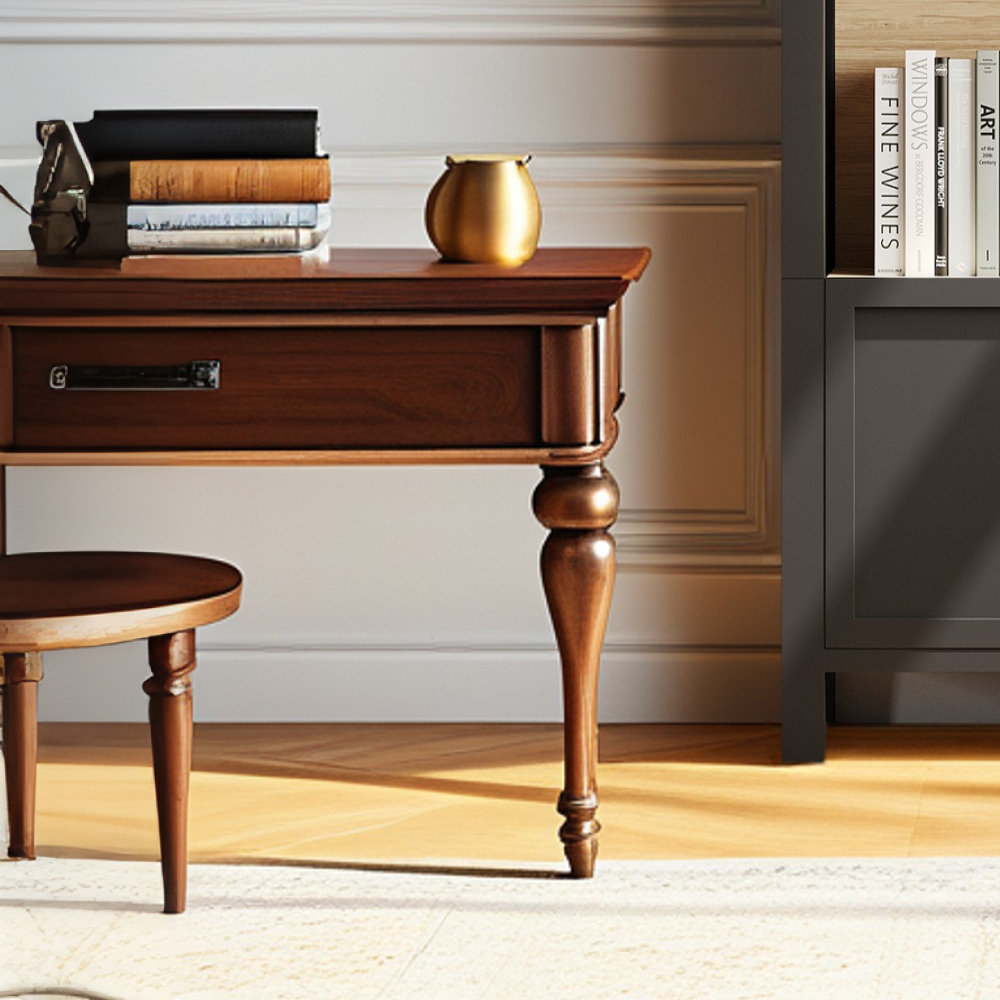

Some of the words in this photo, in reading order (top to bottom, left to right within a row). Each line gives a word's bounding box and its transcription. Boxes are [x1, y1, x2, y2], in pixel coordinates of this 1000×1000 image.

[910, 58, 928, 151] WINDOWS
[980, 104, 995, 140] ART
[881, 97, 899, 153] FINE
[937, 127, 945, 152] FRANK
[937, 153, 945, 177] LLOYD
[881, 165, 899, 249] WINES
[937, 178, 945, 208] WRIGHT
[915, 199, 924, 237] GOODMAN
